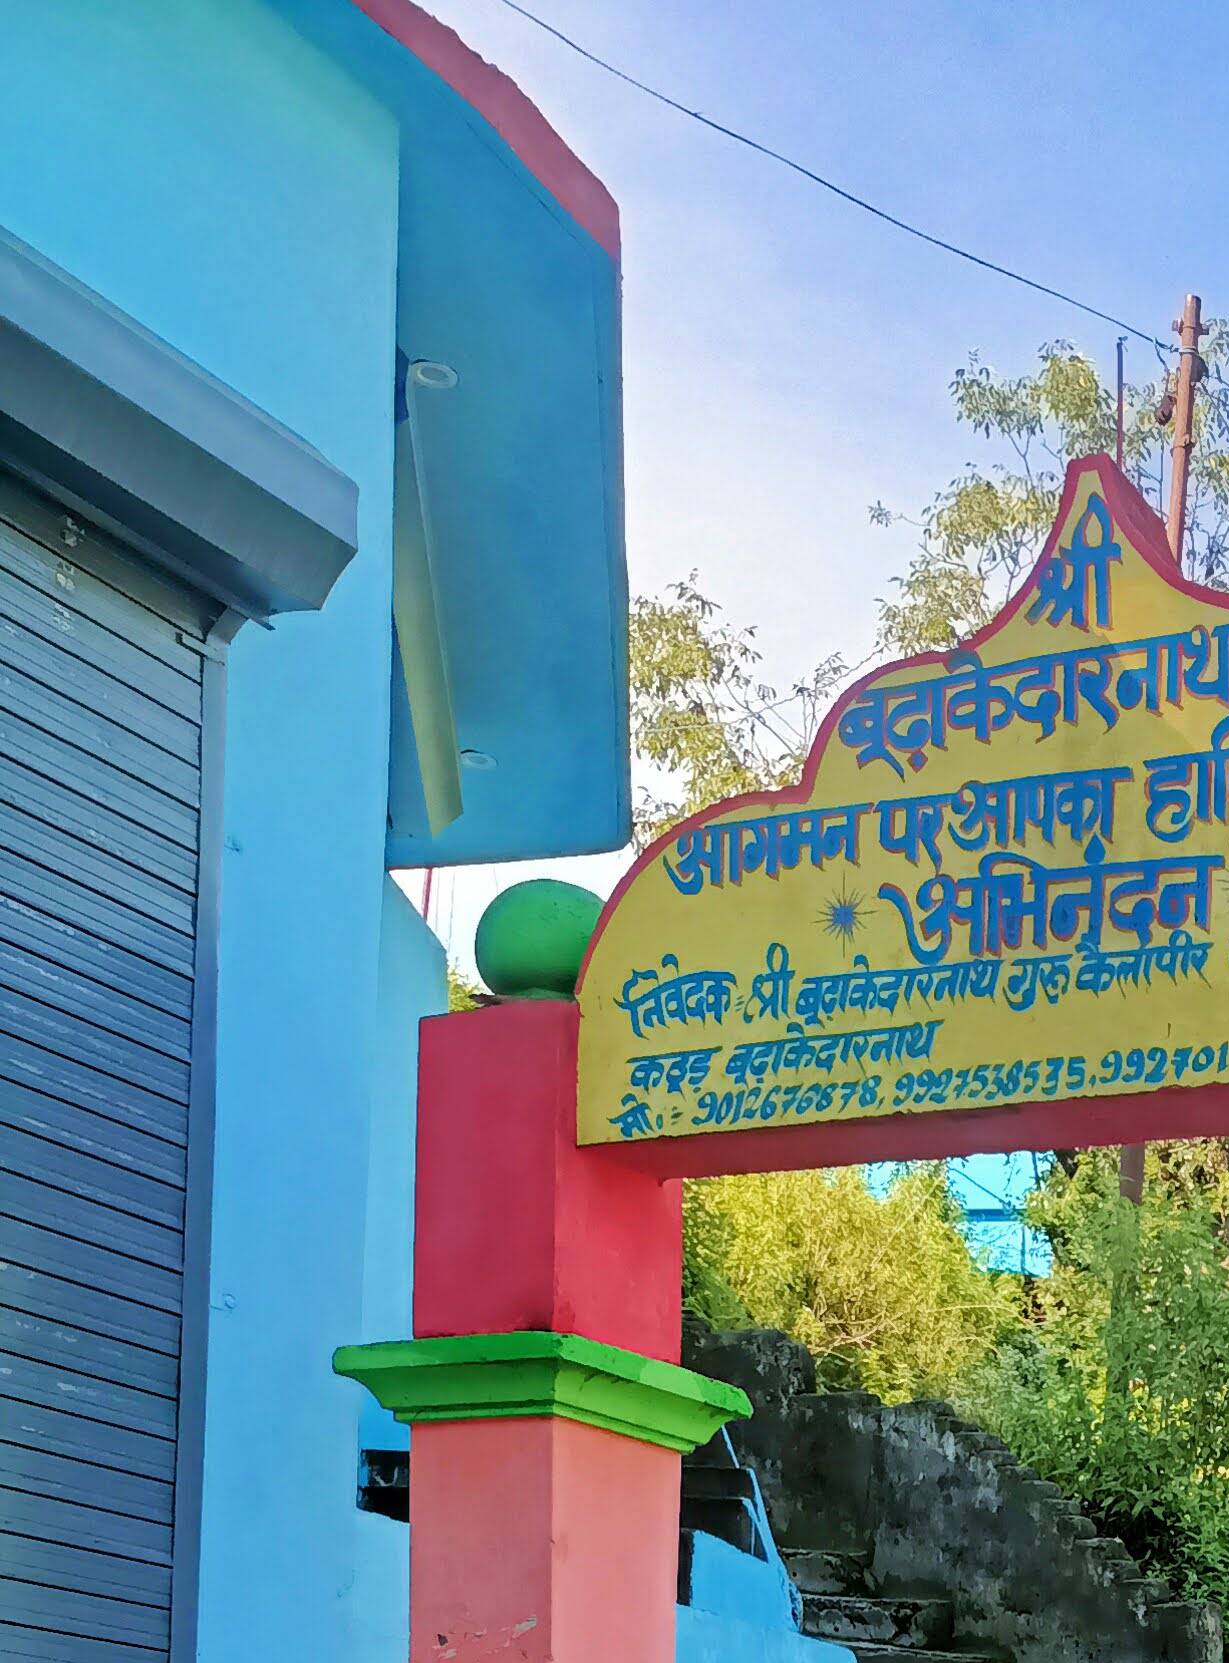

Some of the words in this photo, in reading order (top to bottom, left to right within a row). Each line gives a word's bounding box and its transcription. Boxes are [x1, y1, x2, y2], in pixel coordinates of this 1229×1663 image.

[1024, 491, 1122, 632] श्री
[663, 803, 875, 895] आगमन
[874, 792, 962, 877] पर
[948, 766, 1133, 852] आपका
[880, 834, 1225, 966] अभिनंदन
[743, 942, 796, 1024] श्री
